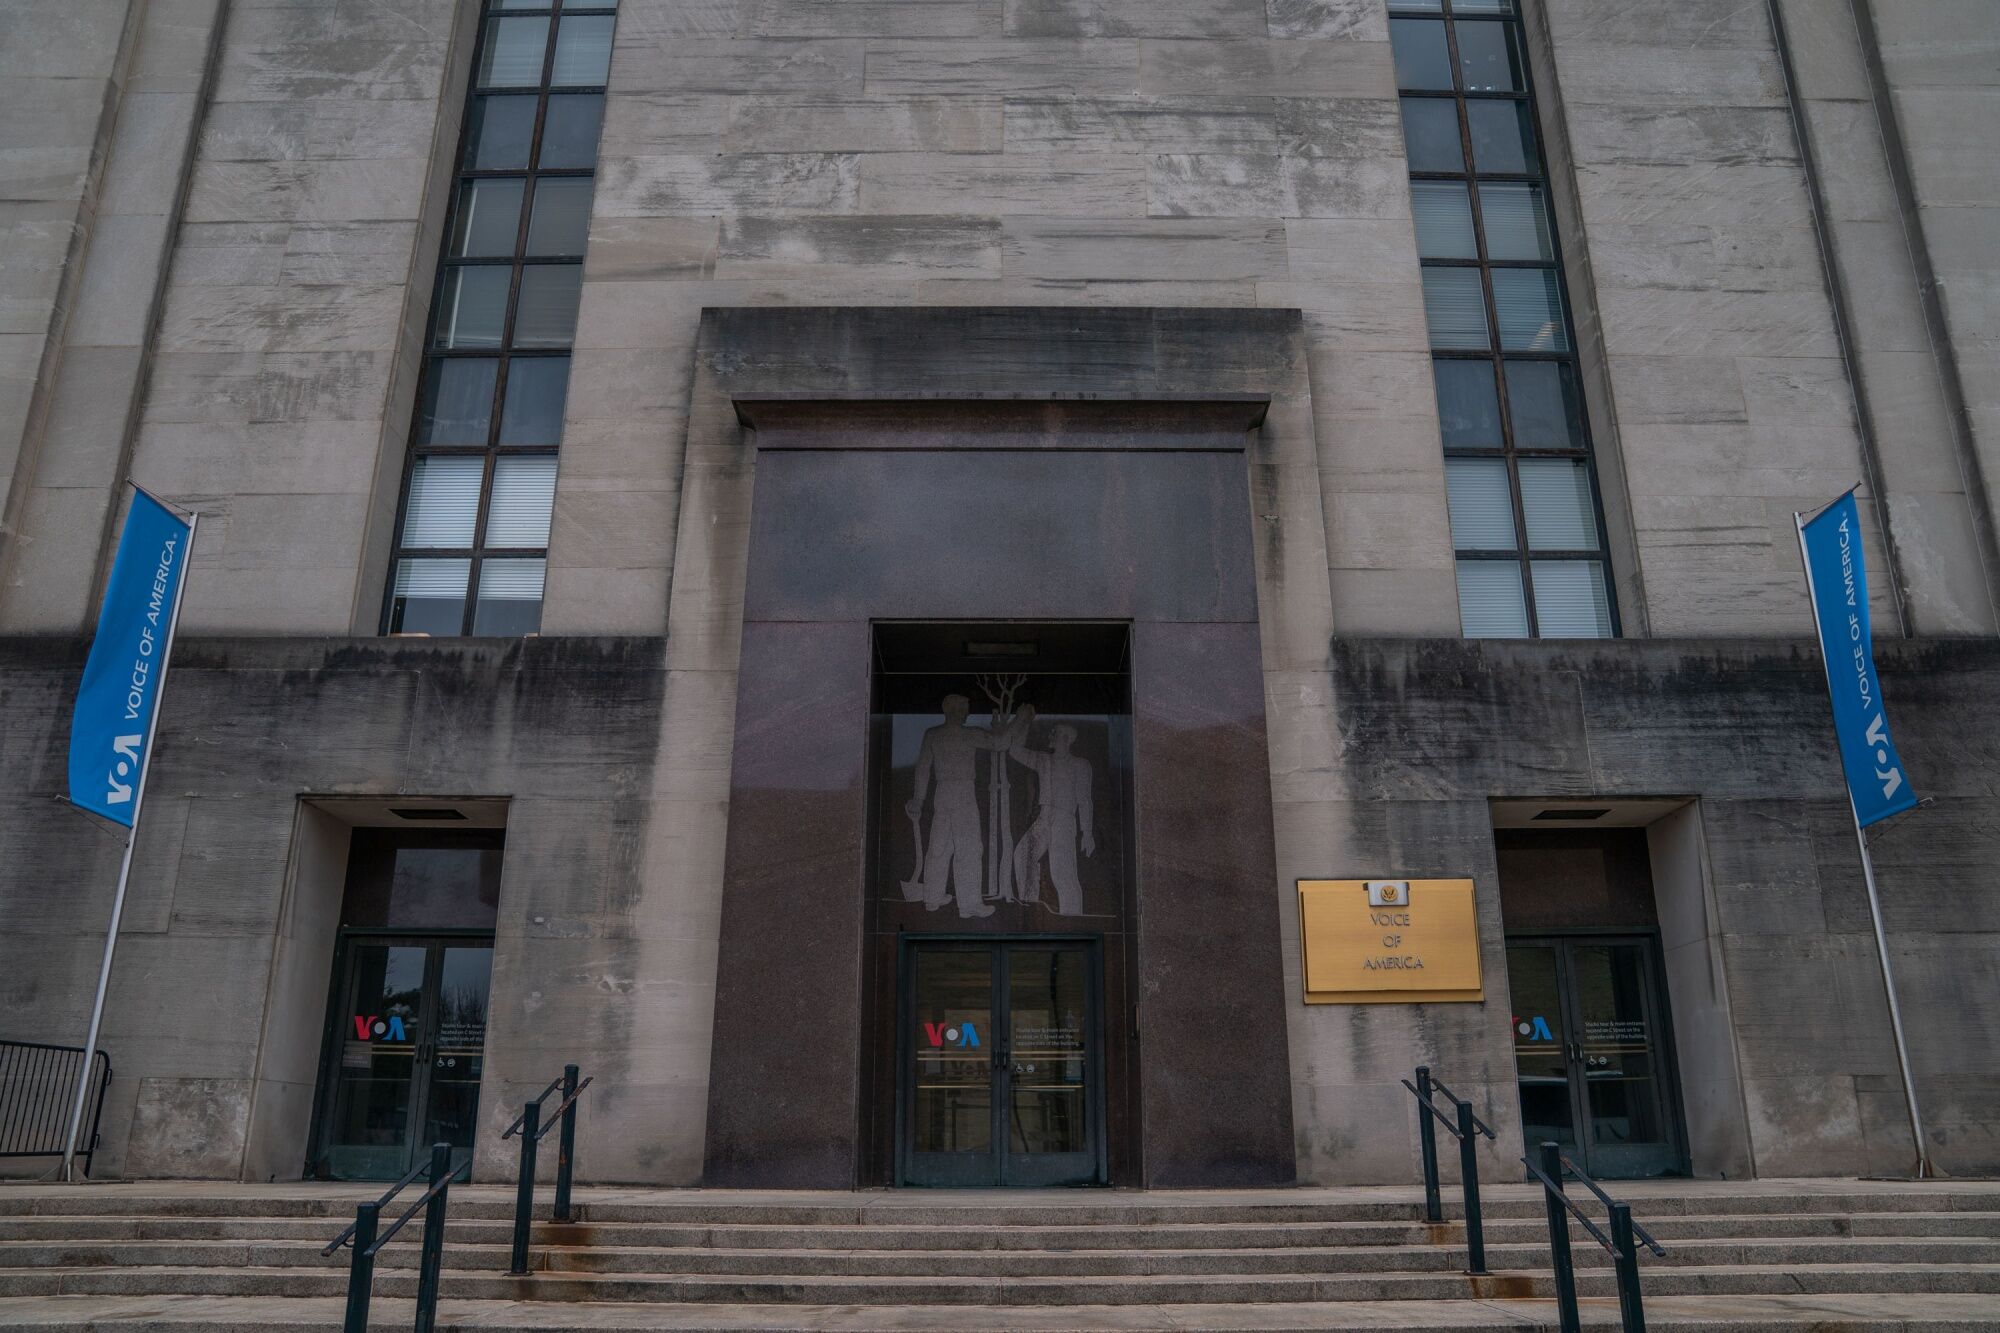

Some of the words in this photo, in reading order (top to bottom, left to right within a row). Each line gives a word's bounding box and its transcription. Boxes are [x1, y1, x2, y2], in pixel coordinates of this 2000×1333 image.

[1838, 517, 1857, 606] AMERICA
[146, 539, 176, 627] AMERICA
[139, 627, 155, 657] OF
[1849, 614, 1860, 642] OF
[125, 660, 149, 721] VOICE
[1854, 644, 1872, 710] VOICE
[107, 733, 142, 804] VOA
[1865, 712, 1903, 801] VOA
[1370, 913, 1410, 927] VOICE
[1383, 935, 1401, 948] OF
[1363, 956, 1425, 970] AMERICA
[354, 1015, 406, 1041] VOA
[924, 1022, 981, 1048] VOA
